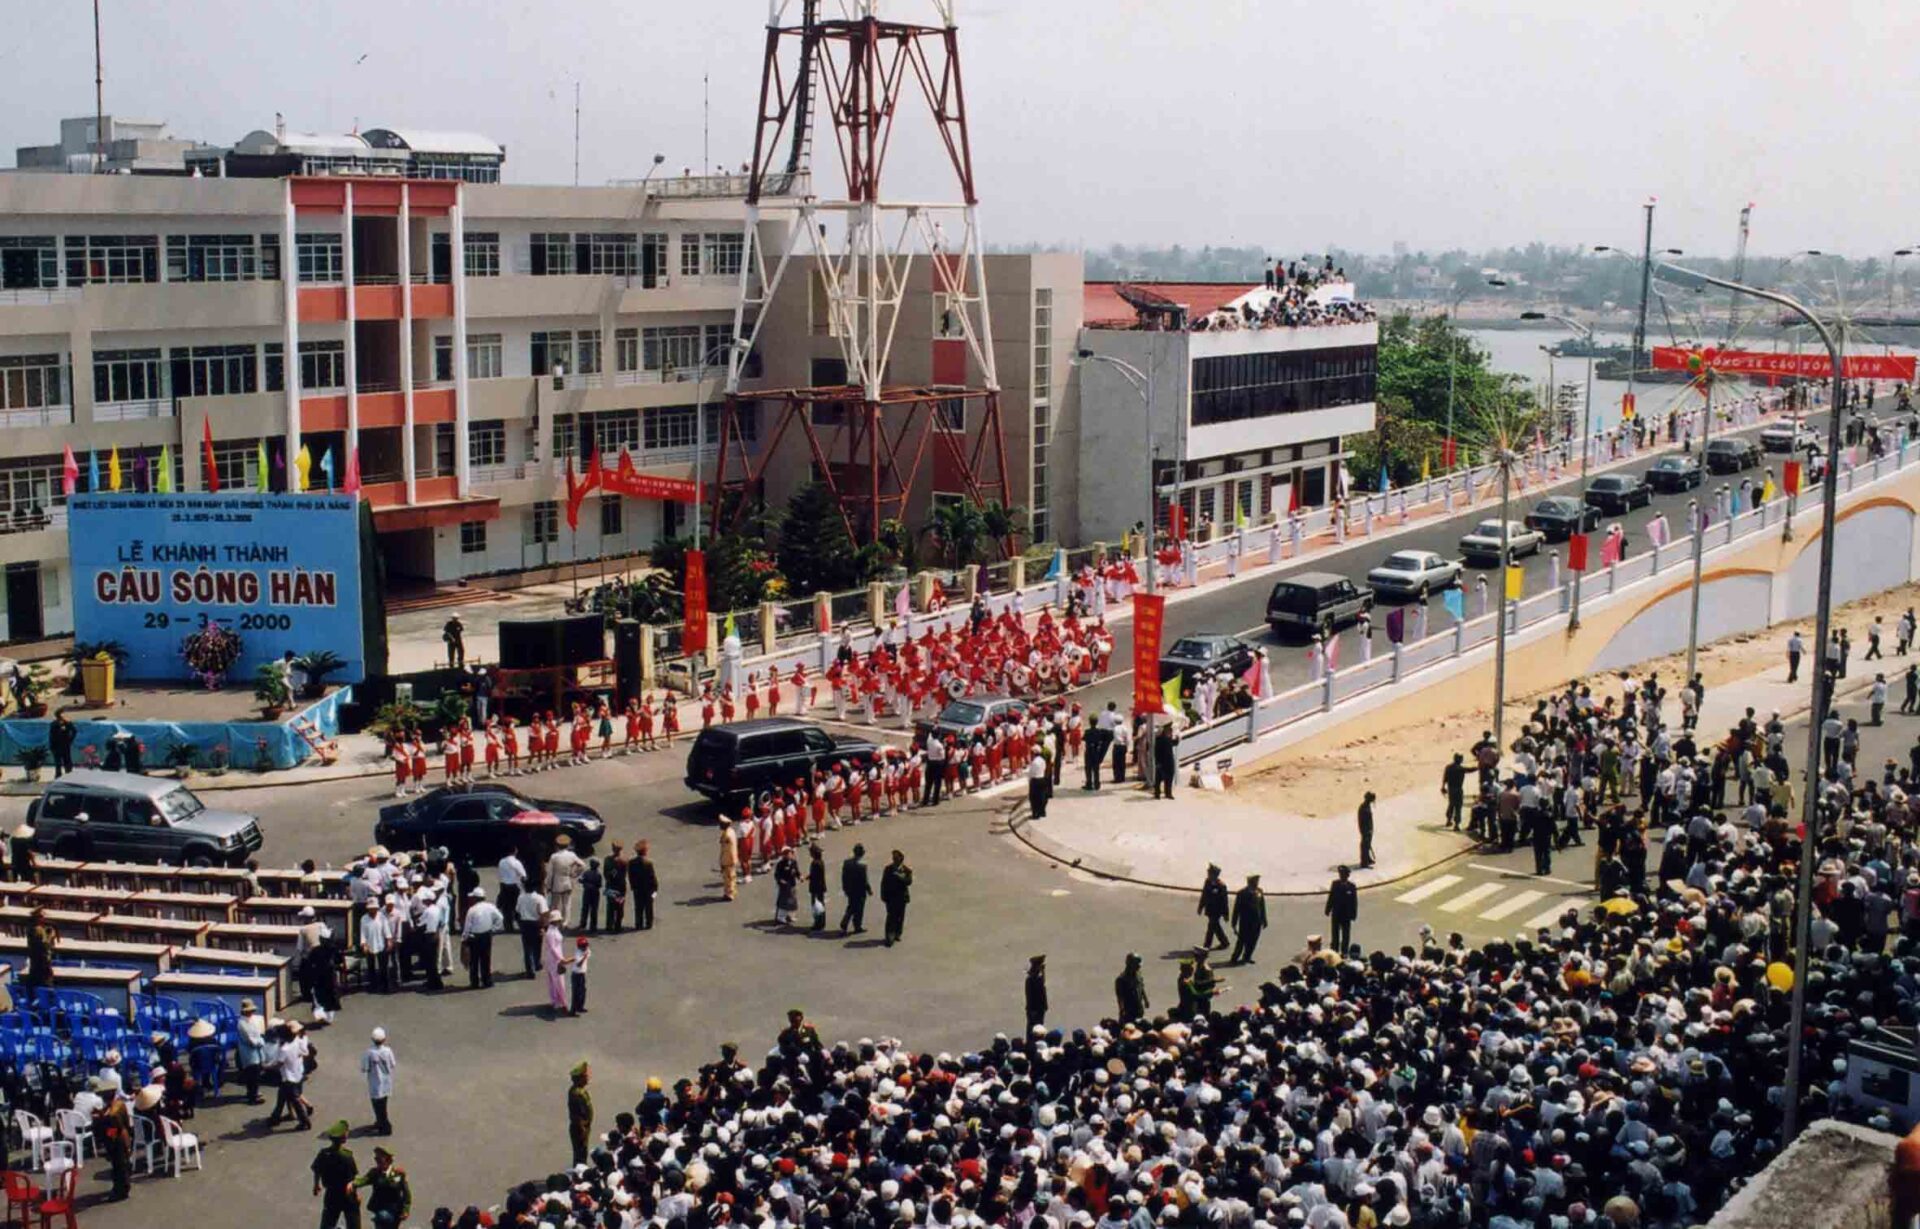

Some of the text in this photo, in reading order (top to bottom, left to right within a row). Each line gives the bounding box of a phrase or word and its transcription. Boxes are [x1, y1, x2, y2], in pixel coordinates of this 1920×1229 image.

[117, 539, 288, 563] LỄ KHÁNH THÀNH
[95, 566, 337, 606] CẦU SÔNG HÀN
[144, 612, 169, 629] 29
[197, 612, 209, 629] 3
[240, 613, 291, 630] 2000
